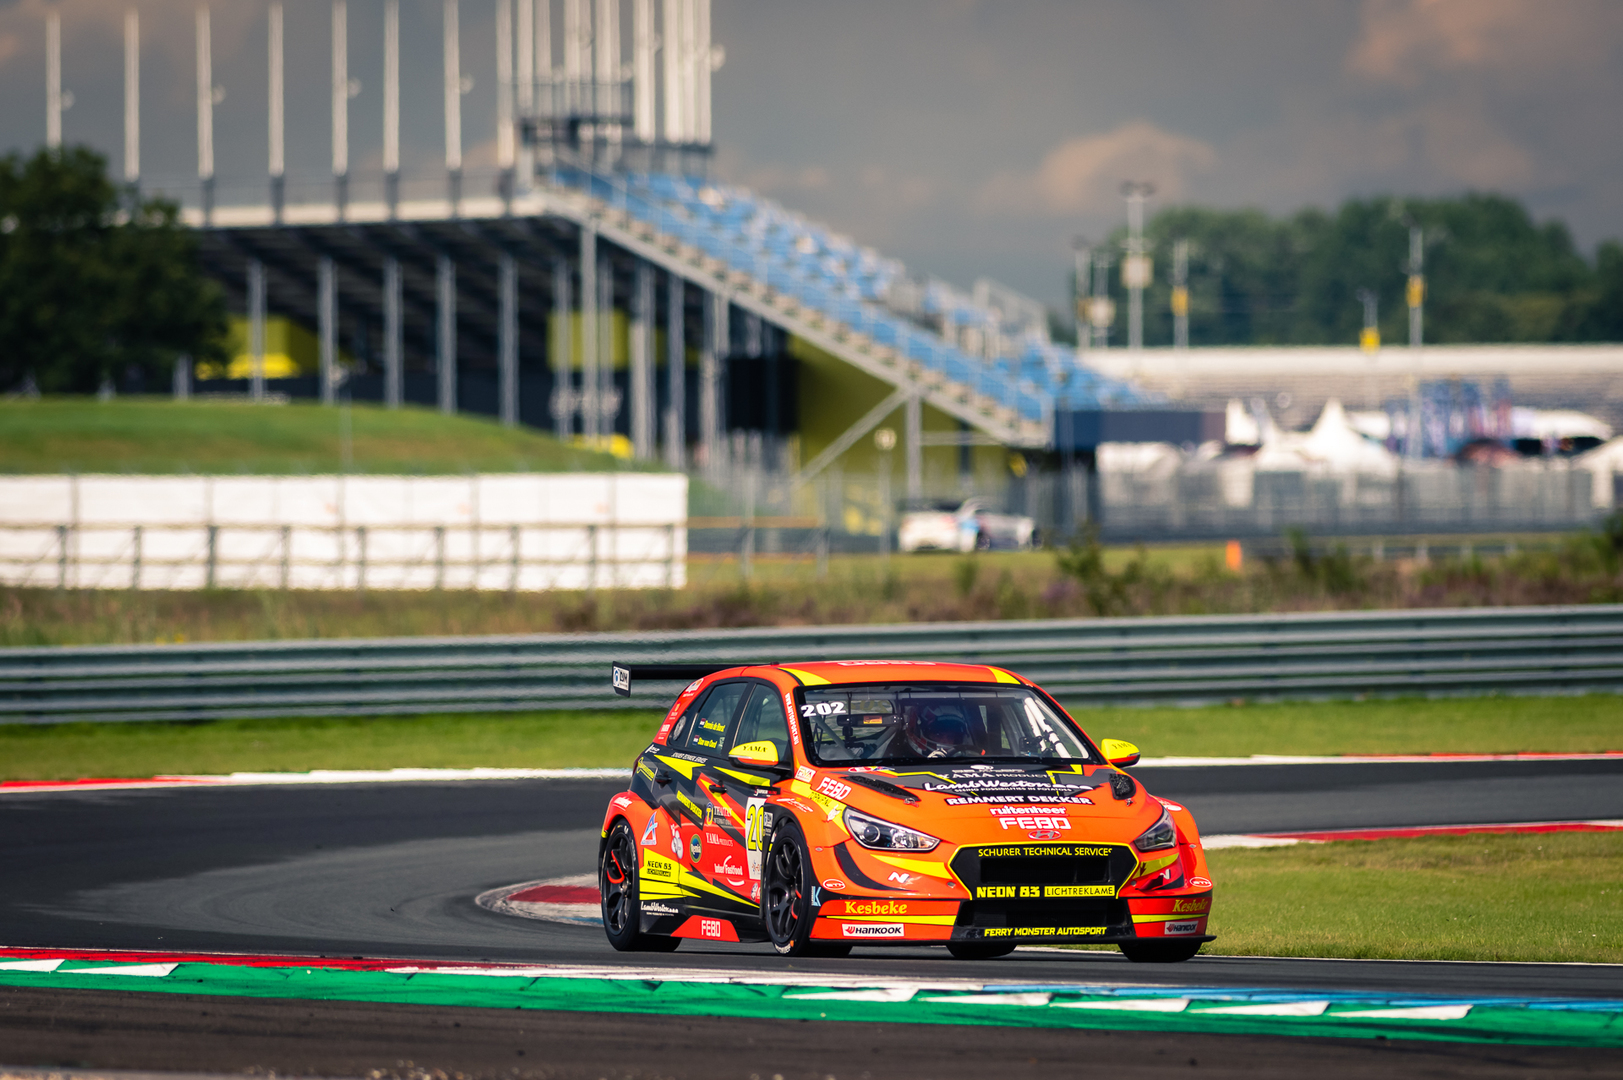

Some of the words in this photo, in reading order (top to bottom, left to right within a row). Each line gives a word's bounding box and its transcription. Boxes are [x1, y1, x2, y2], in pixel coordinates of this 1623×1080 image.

[801, 701, 846, 718] 202
[743, 745, 767, 753] YAMA
[816, 777, 852, 800] FEBO
[946, 795, 1025, 805] REMMERT
[1027, 795, 1093, 805] DEKKER
[989, 805, 1066, 815] ruitenheer
[999, 817, 1072, 830] FEBO
[978, 848, 1021, 857] SCHURER
[1023, 847, 1072, 856] TECHNICAL
[976, 885, 1016, 898] NEON
[1019, 885, 1040, 898] 83
[1046, 885, 1114, 896] LICHTREKLAME
[845, 901, 908, 914] Kesbeke
[1172, 899, 1208, 912] Kesbeke
[701, 920, 721, 937] FEBO
[984, 928, 1013, 937] FERRY
[1014, 927, 1055, 936] MONSTER
[1057, 927, 1107, 936] AUTOSPORT
